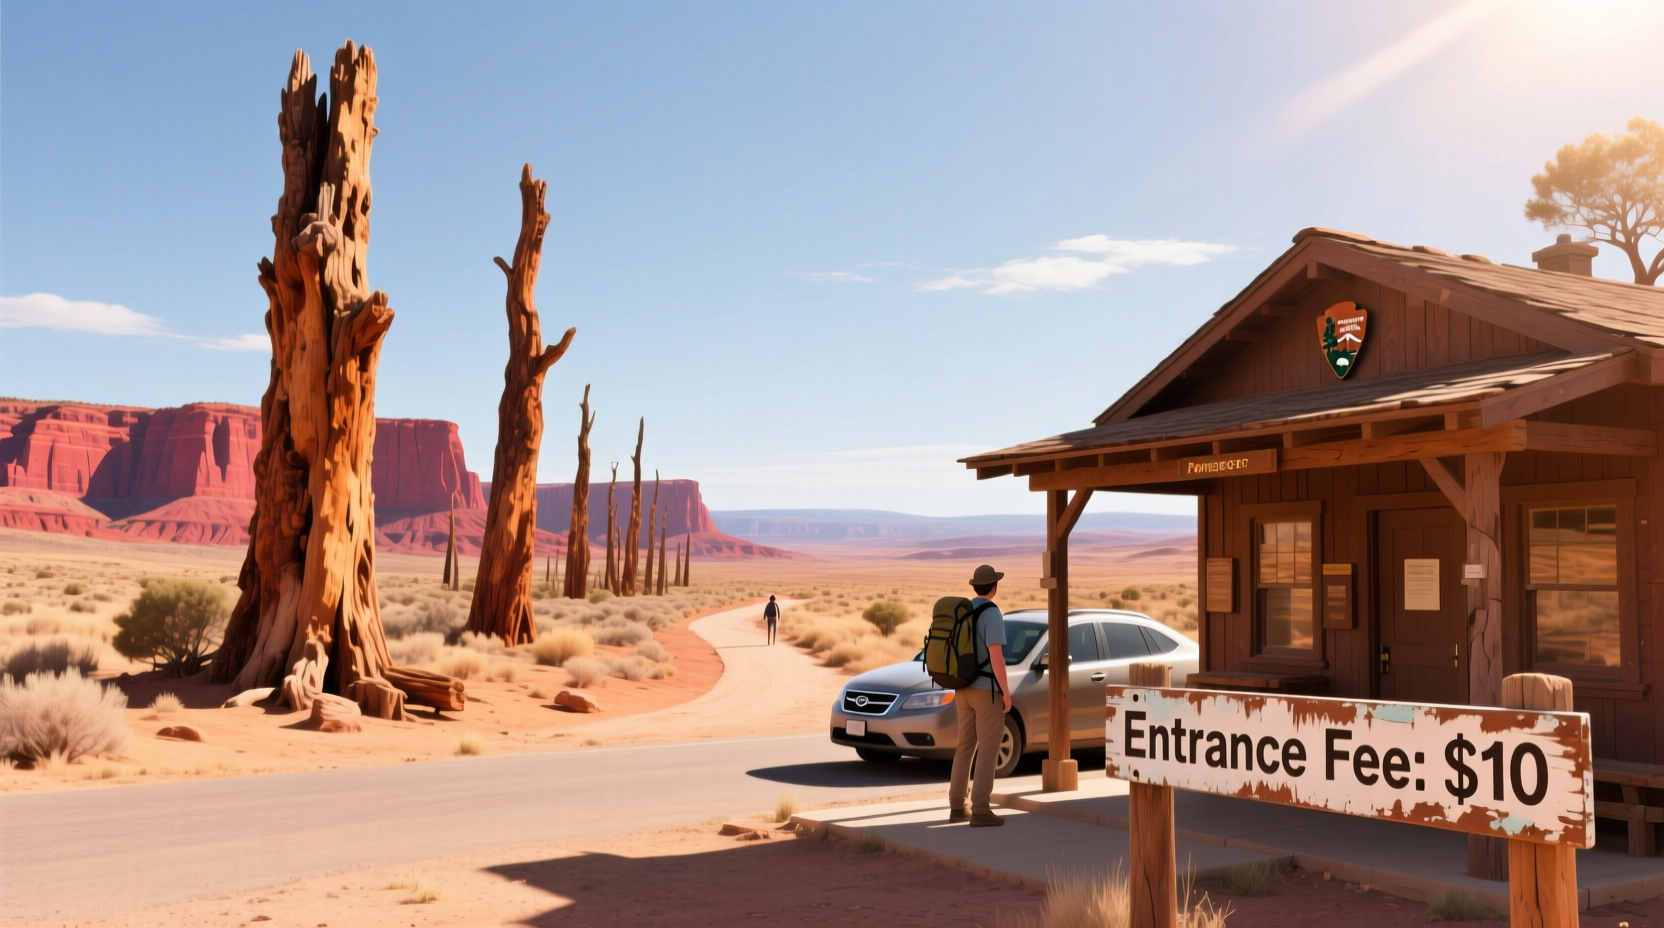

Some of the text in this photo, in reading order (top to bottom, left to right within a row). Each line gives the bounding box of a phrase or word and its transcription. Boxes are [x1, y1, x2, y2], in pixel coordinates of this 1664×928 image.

[1124, 710, 1549, 806] Entrance Fee: $10
